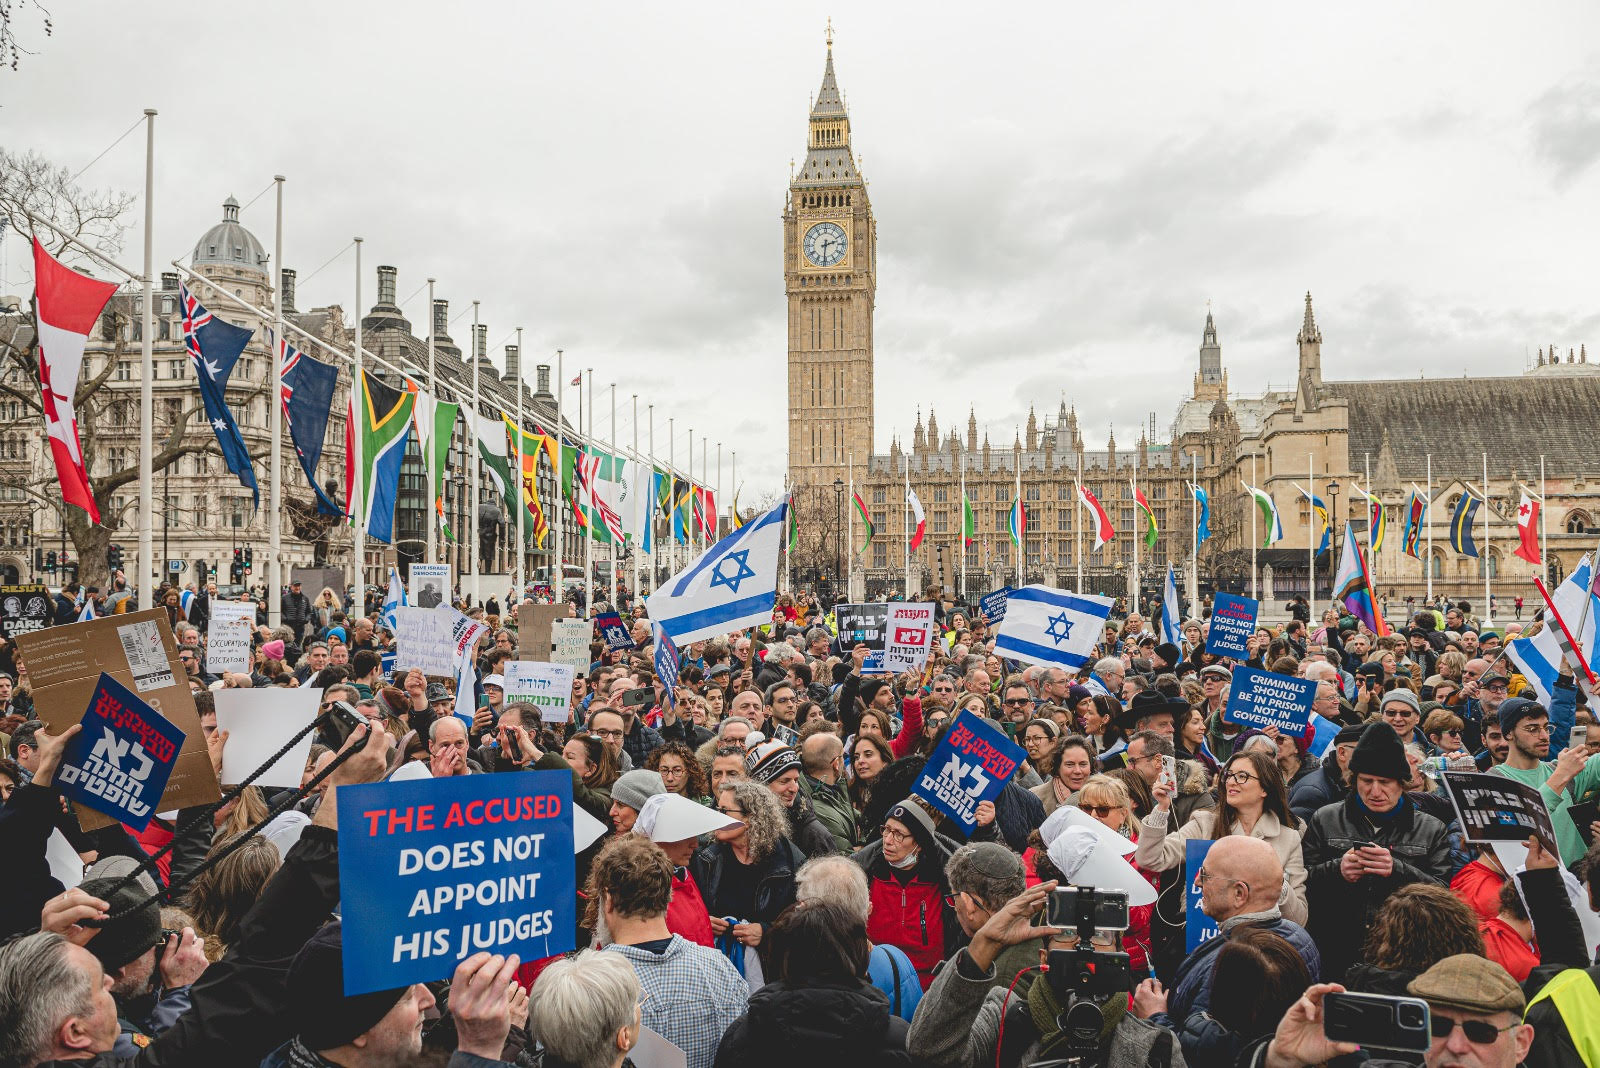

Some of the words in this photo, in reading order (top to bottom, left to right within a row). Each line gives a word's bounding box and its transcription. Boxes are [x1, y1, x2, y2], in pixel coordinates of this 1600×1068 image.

[1218, 609, 1252, 620] ACCUSED
[1230, 602, 1245, 610] THE
[4, 620, 44, 630] DARK
[1214, 616, 1235, 625] DOES
[1236, 620, 1254, 628] NOT
[1214, 625, 1251, 636] APPOINT
[210, 639, 248, 647] OCCUPATION
[900, 629, 922, 642] לא
[1213, 640, 1244, 651] JUDGES
[889, 646, 925, 654] היהדות
[518, 679, 551, 689] יהודית
[1250, 675, 1306, 693] CRIMINALS
[1252, 685, 1296, 700] SHOULD
[100, 687, 122, 711] של
[1238, 692, 1252, 701] BE
[1254, 695, 1267, 704] IN
[1268, 698, 1306, 712] PRISON
[1233, 710, 1305, 732] GOVERNMENT
[1253, 705, 1278, 716] NOT
[1278, 711, 1291, 719] IN
[122, 708, 176, 753] ממשלה
[955, 721, 974, 740] של
[91, 726, 154, 780] לא
[948, 731, 1010, 780] עבריינים
[972, 735, 1016, 770] ממשלה
[82, 754, 144, 797] תמנה
[941, 753, 990, 797] לא
[59, 764, 151, 816] שופטים
[921, 775, 976, 825] שופטים
[936, 772, 975, 808] תמנה
[364, 805, 435, 836] THE
[443, 795, 561, 829] ACCUSED
[399, 840, 485, 876] DOES
[493, 834, 545, 863] NOT
[408, 873, 541, 917] APPOINT
[392, 929, 450, 963] HIS
[456, 910, 553, 960] JUDGES
